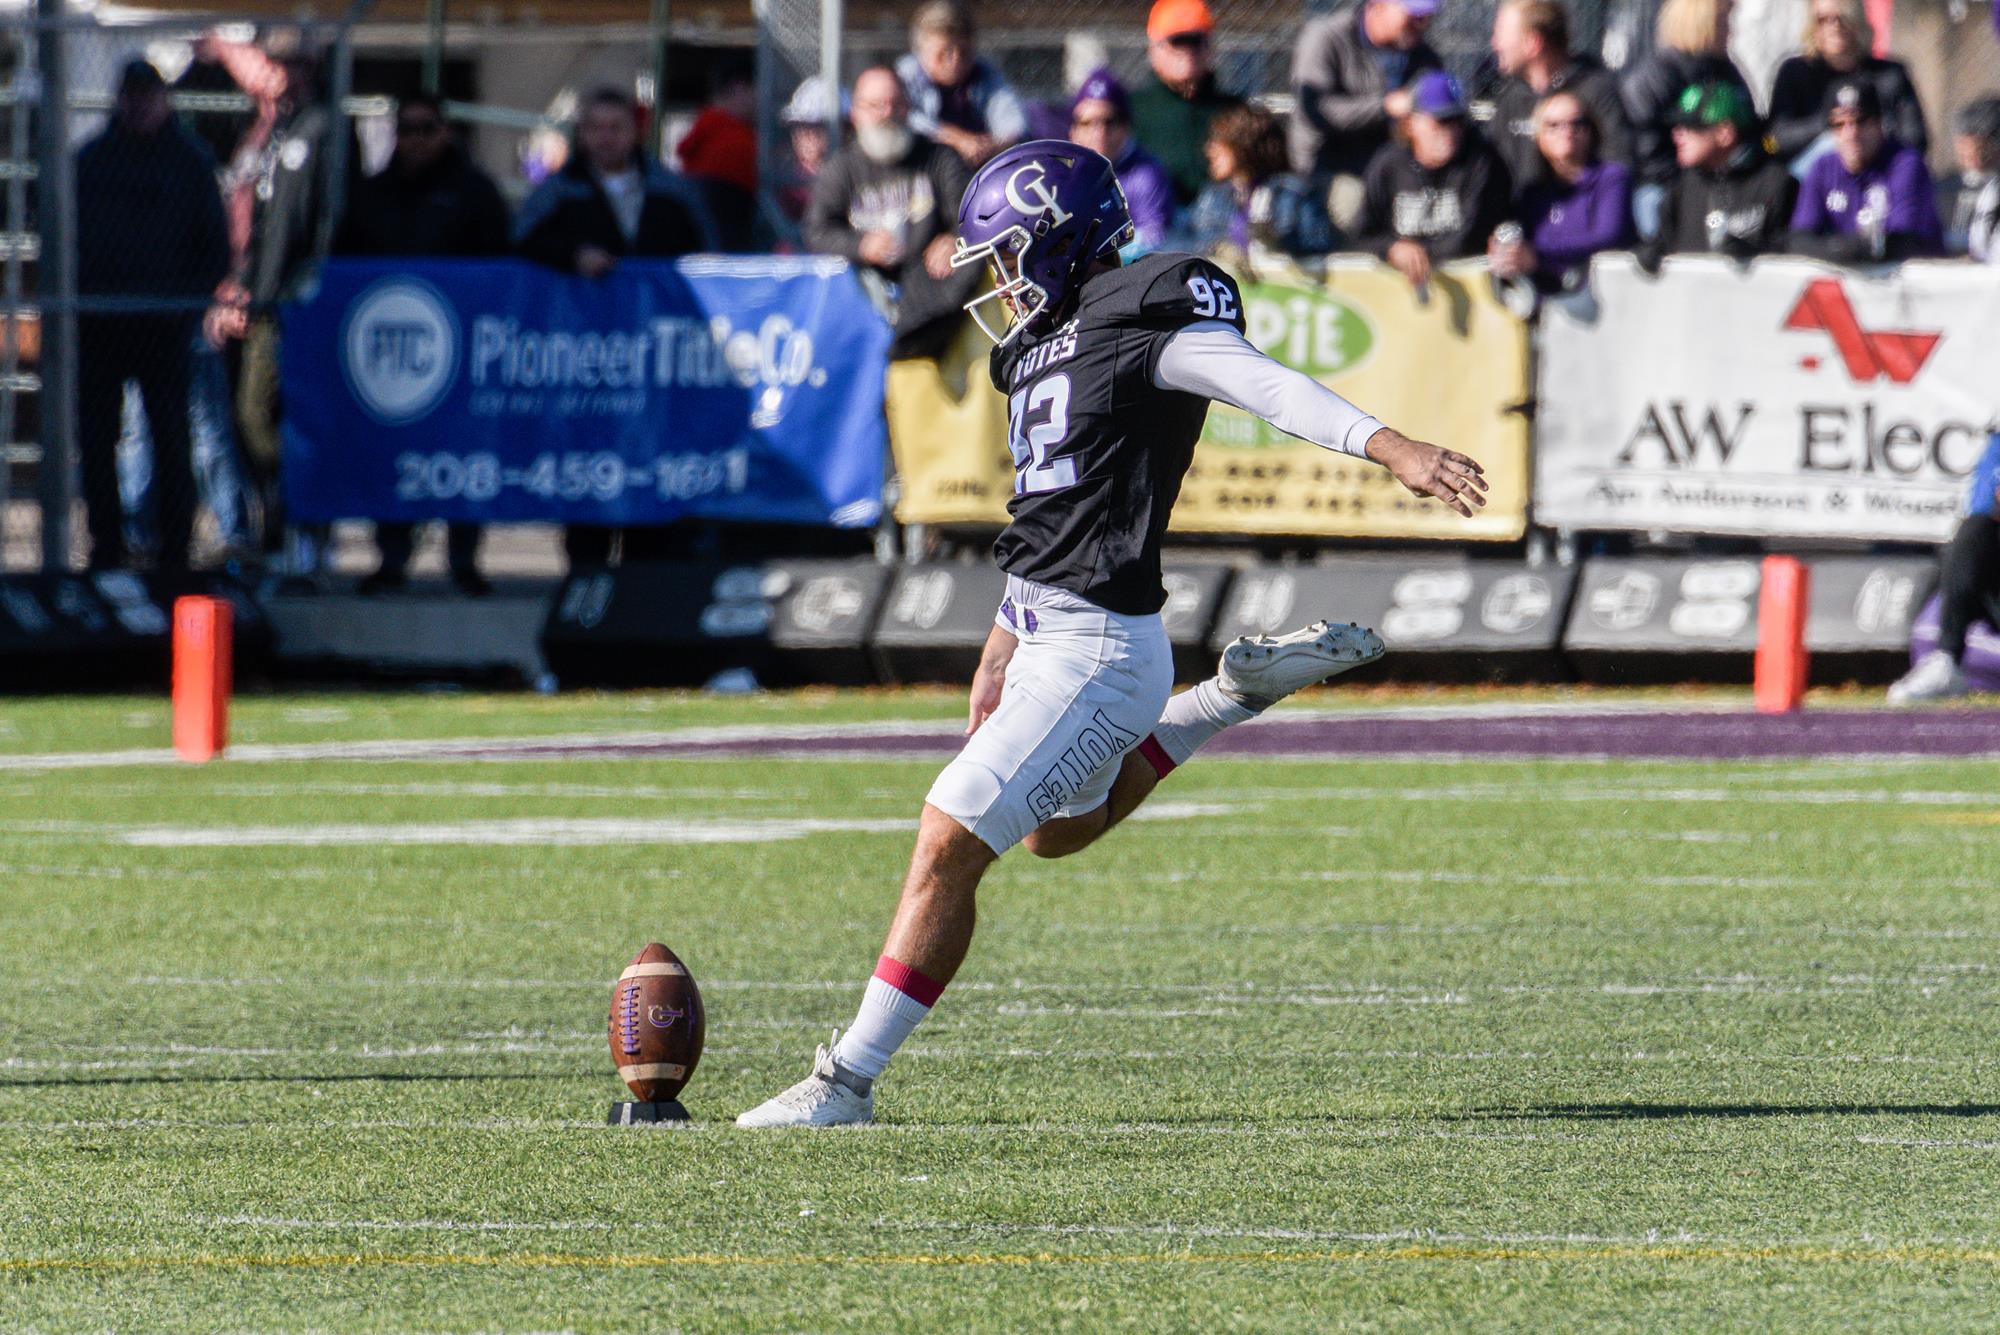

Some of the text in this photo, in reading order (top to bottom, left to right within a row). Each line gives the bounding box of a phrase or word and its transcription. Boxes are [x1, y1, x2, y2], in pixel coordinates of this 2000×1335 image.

[1187, 276, 1237, 319] 92
[1014, 333, 1078, 384] YOTES
[1617, 402, 2000, 478] AW Elec
[1026, 708, 1140, 825] YOTES
